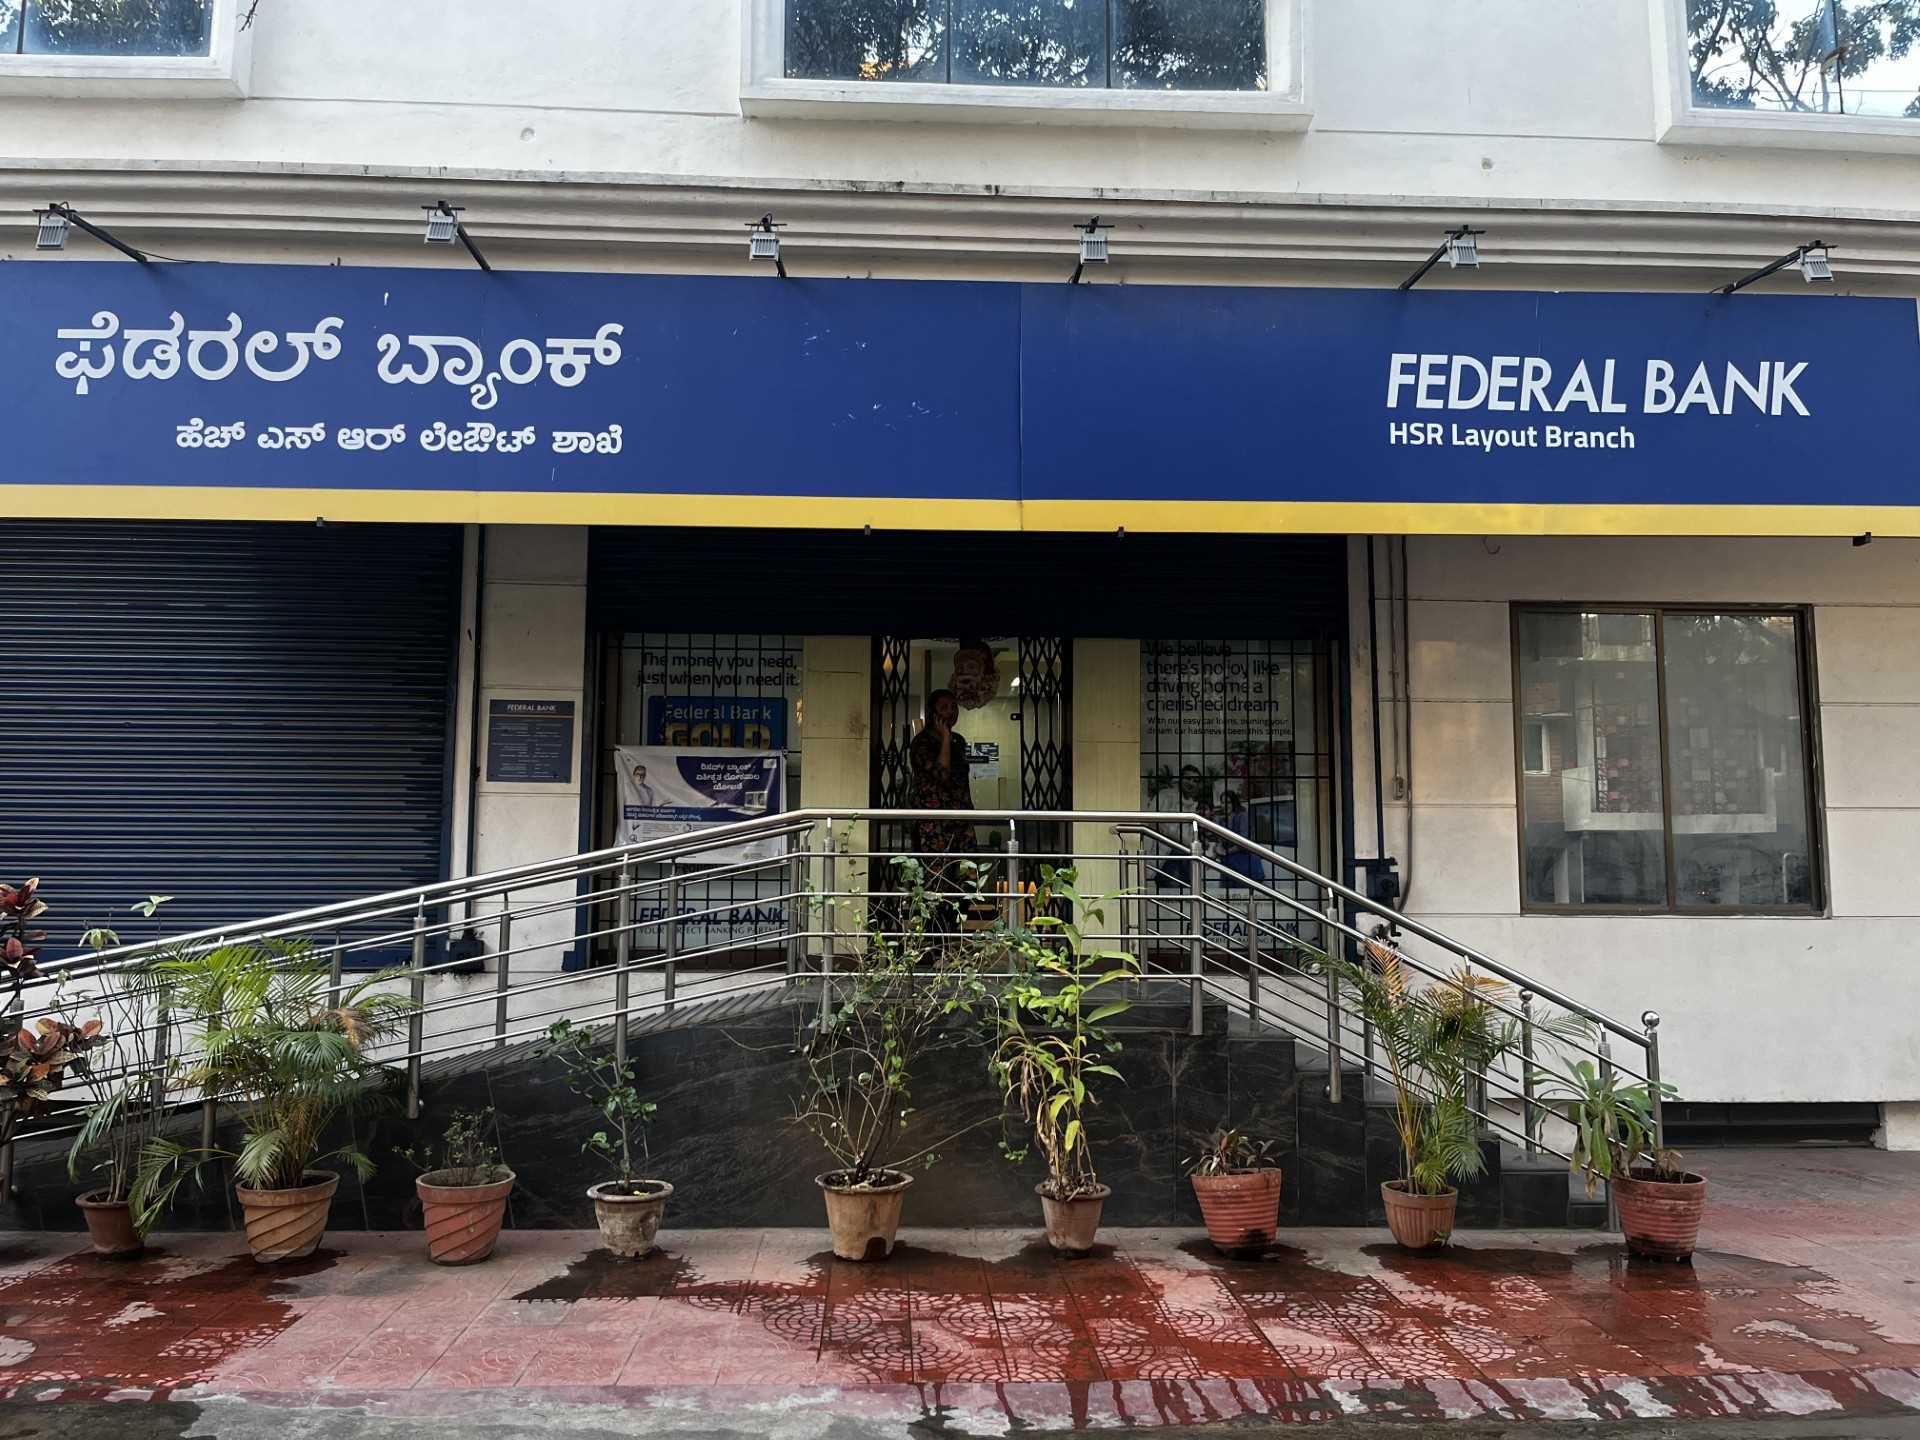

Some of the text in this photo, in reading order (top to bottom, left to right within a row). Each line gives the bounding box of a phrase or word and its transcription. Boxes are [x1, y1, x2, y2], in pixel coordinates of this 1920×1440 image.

[55, 310, 625, 410] ಫೆಡರಲ್ ಬ್ಯಾಂಕ್
[1386, 353, 1811, 416] FEDERAL BANK
[176, 417, 623, 454] ಹೆಚ್ ಎಸ್ ಆರ್ ಲೇಔಟ್ ಶಾಖೆ
[1389, 422, 1635, 453] HSR Layout Branch
[642, 652, 667, 666] The
[672, 655, 723, 671] money
[727, 656, 754, 671] you
[1202, 663, 1223, 675] no
[1224, 659, 1248, 678] joy
[1252, 659, 1280, 675] like
[669, 672, 711, 685] when
[713, 673, 742, 688] you
[746, 671, 782, 686] need
[1203, 678, 1248, 693] home
[1252, 682, 1264, 693] a
[664, 704, 772, 720] Federal Bank
[1227, 697, 1279, 712] dream
[729, 906, 785, 926] BANK
[1186, 921, 1249, 937] FDERAL
